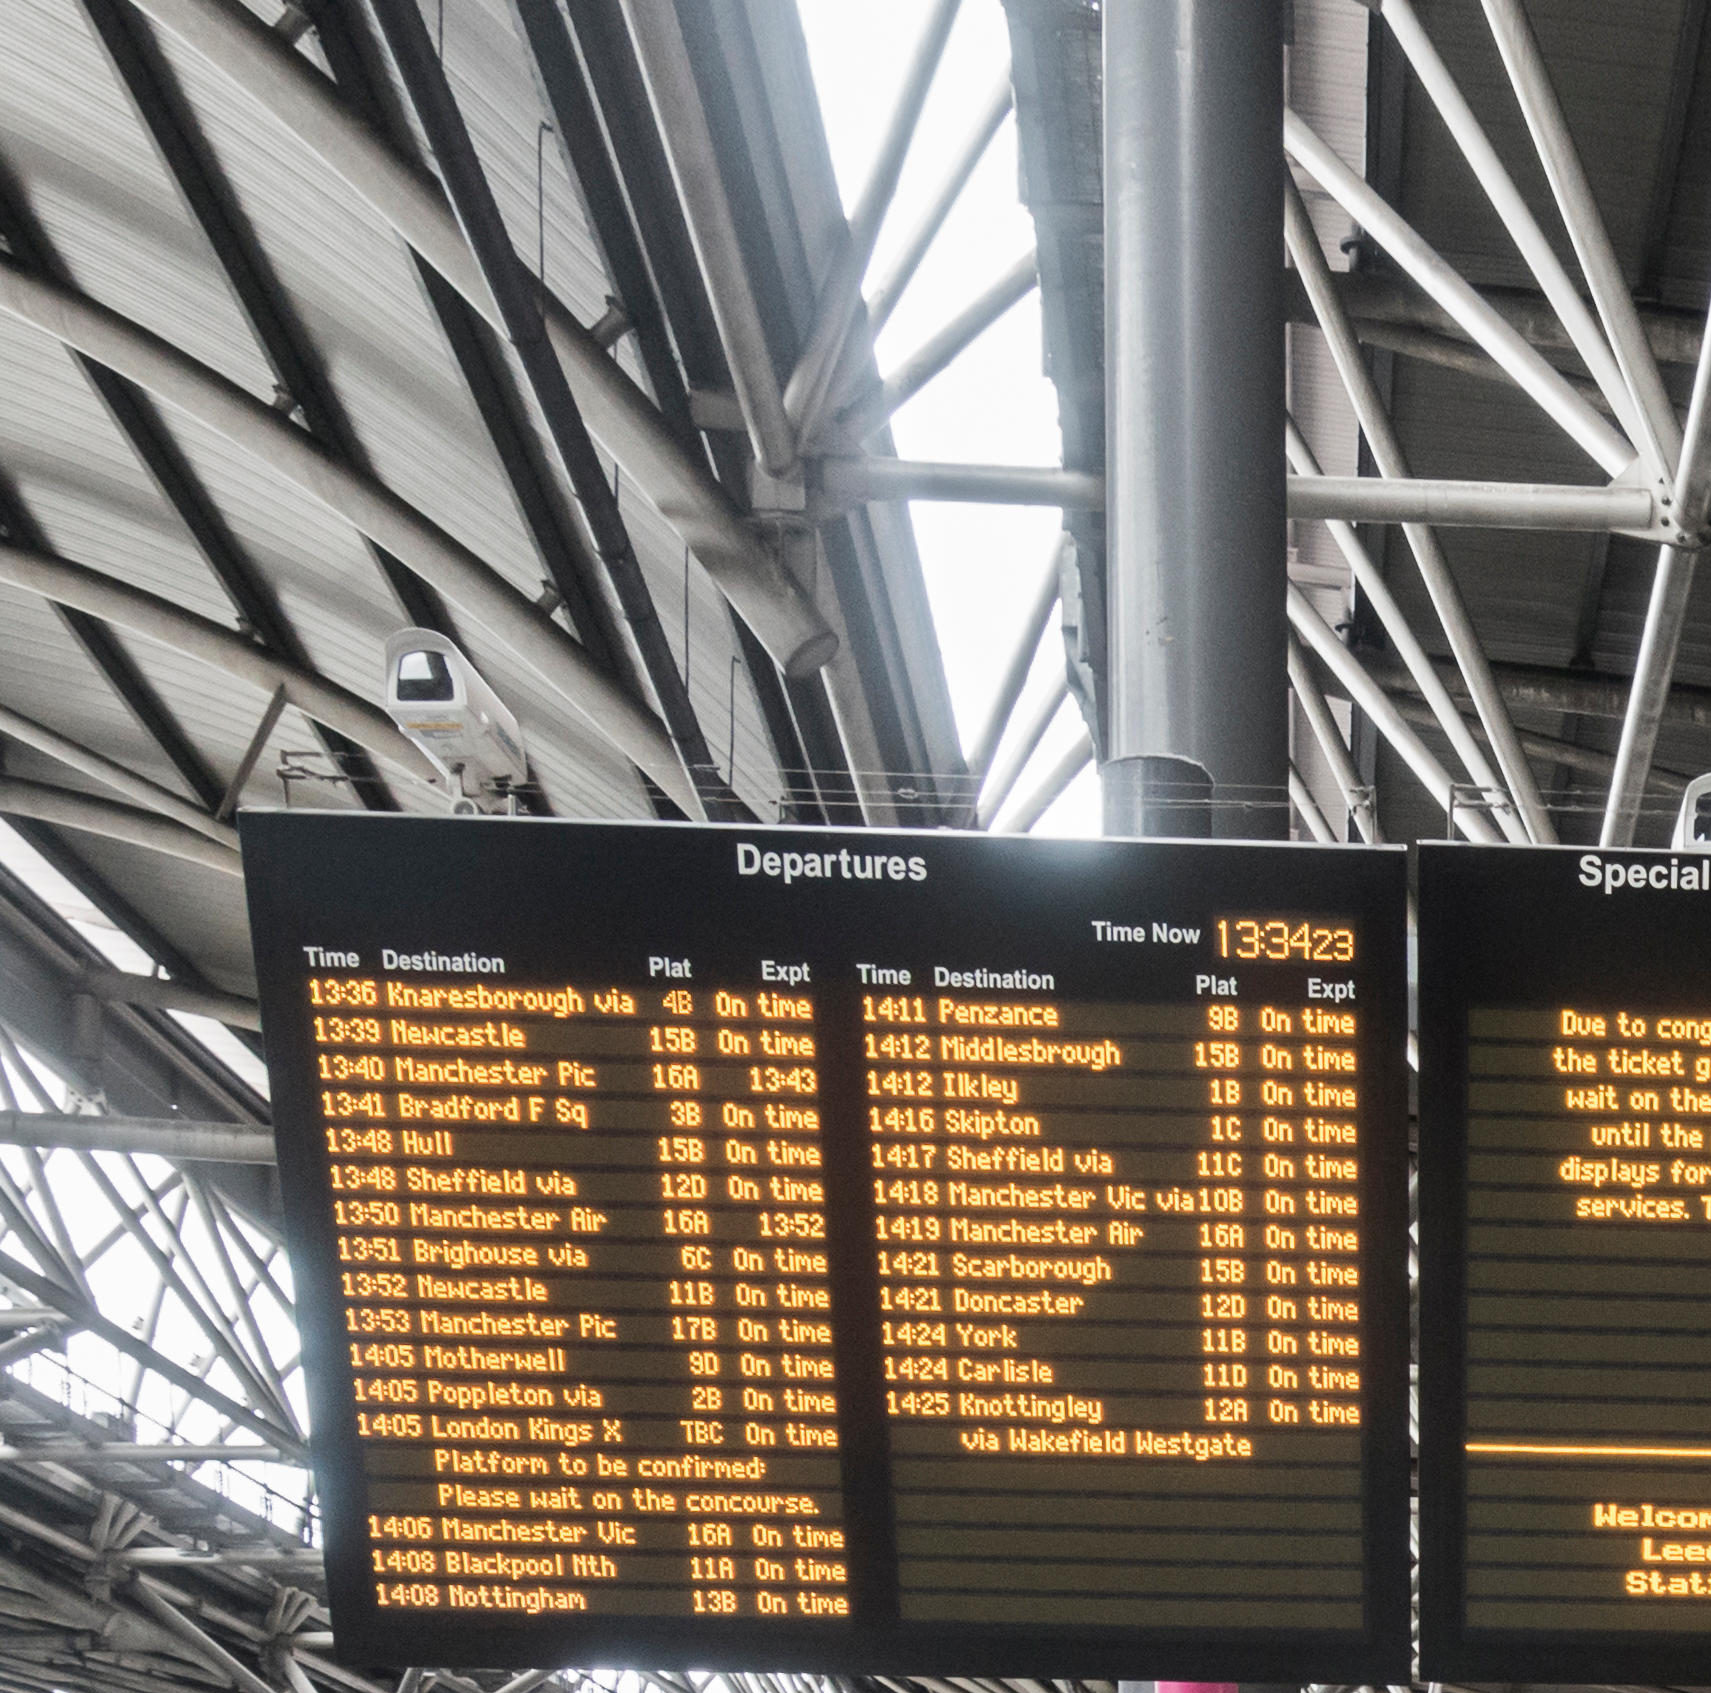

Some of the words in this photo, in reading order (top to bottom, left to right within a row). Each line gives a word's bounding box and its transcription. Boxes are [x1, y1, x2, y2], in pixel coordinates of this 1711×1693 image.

[737, 843, 929, 884] Departures
[1579, 855, 1710, 894] Special
[1092, 921, 1146, 943] Time
[1152, 923, 1201, 944] Now
[303, 946, 360, 968] Time
[382, 948, 505, 973] Destination
[649, 957, 692, 978] Plat
[761, 960, 811, 984] Expt
[856, 964, 912, 986] Time
[934, 967, 1055, 990] Destination
[1197, 975, 1238, 996] Plat
[1307, 977, 1356, 1001] Expt
[310, 979, 378, 1006] 13:36
[387, 982, 585, 1018] Knaresborough
[594, 989, 635, 1014] via
[663, 991, 693, 1014] 4B
[716, 991, 748, 1017] On
[757, 993, 813, 1019] time
[863, 996, 927, 1023] 14:11
[939, 998, 1058, 1027] Penzance
[1208, 1005, 1239, 1032] 9B
[1260, 1007, 1292, 1033] On
[1302, 1008, 1355, 1035] time
[1561, 1010, 1606, 1037] Due
[1617, 1012, 1646, 1038] to
[319, 1054, 385, 1081] 13:40
[394, 1057, 548, 1085] Manchester
[558, 1061, 596, 1087] Pic
[653, 1064, 700, 1090] 16A
[750, 1067, 817, 1093] 13:43
[1553, 1047, 1597, 1073] the
[1608, 1048, 1685, 1076] ticket
[867, 1071, 934, 1097] 14:12
[943, 1072, 1018, 1104] Ilkley
[1210, 1079, 1241, 1105] 1B
[1262, 1080, 1293, 1105] On
[1303, 1082, 1356, 1108] time
[1566, 1085, 1619, 1110] wait
[1629, 1091, 1659, 1112] on
[326, 1128, 393, 1153] 13:48
[402, 1130, 453, 1155] Hull
[659, 1137, 705, 1163] 15B
[725, 1139, 757, 1164] On
[767, 1140, 821, 1166] time
[1592, 1122, 1650, 1147] until
[1660, 1123, 1704, 1149] the
[872, 1144, 936, 1168] 14:17
[946, 1145, 1064, 1173] Sheffield
[1074, 1149, 1114, 1175] via
[1198, 1152, 1242, 1177] 11C
[1264, 1153, 1295, 1178] On
[1304, 1154, 1357, 1180] time
[1559, 1156, 1660, 1188] displays
[335, 1201, 401, 1226] 13:50
[410, 1203, 561, 1230] Manchester
[571, 1207, 607, 1232] Air
[664, 1209, 710, 1234] 16A
[760, 1212, 825, 1238] 13:52
[1576, 1194, 1690, 1220] services.
[876, 1216, 941, 1240] 14:19
[949, 1218, 1098, 1245] Manchester
[1107, 1221, 1144, 1245] Air
[1200, 1223, 1244, 1248] 16A
[1264, 1224, 1296, 1249] On
[1305, 1226, 1358, 1251] time
[342, 1273, 408, 1298] 13:52
[417, 1274, 548, 1301] Newcastle
[670, 1281, 715, 1305] 11B
[736, 1283, 767, 1306] On
[776, 1284, 830, 1308] time
[880, 1287, 942, 1311] 14:21
[953, 1288, 1084, 1314] Doncaster
[1202, 1294, 1247, 1319] 12D
[1265, 1295, 1296, 1320] On
[1307, 1296, 1358, 1321] time
[350, 1343, 415, 1368] 14:05
[424, 1346, 565, 1371] Motherwell
[689, 1351, 720, 1376] 9D
[741, 1353, 771, 1376] On
[781, 1354, 834, 1378] time
[358, 1413, 423, 1437] 14:05
[432, 1415, 520, 1440] London
[528, 1418, 593, 1446] Kings
[603, 1419, 622, 1441] X
[680, 1421, 724, 1444] TBC
[745, 1422, 776, 1445] On
[785, 1423, 838, 1447] time
[961, 1428, 999, 1452] via
[1009, 1429, 1125, 1454] Wakefield
[1136, 1432, 1252, 1461] Westgate
[435, 1449, 549, 1474] Platform
[558, 1452, 588, 1475] to
[597, 1453, 628, 1477] be
[638, 1455, 766, 1479] confirmed:
[439, 1484, 520, 1508] Please
[530, 1487, 583, 1510] wait
[592, 1492, 622, 1510] on
[632, 1488, 676, 1511] the
[686, 1494, 819, 1514] concourse.
